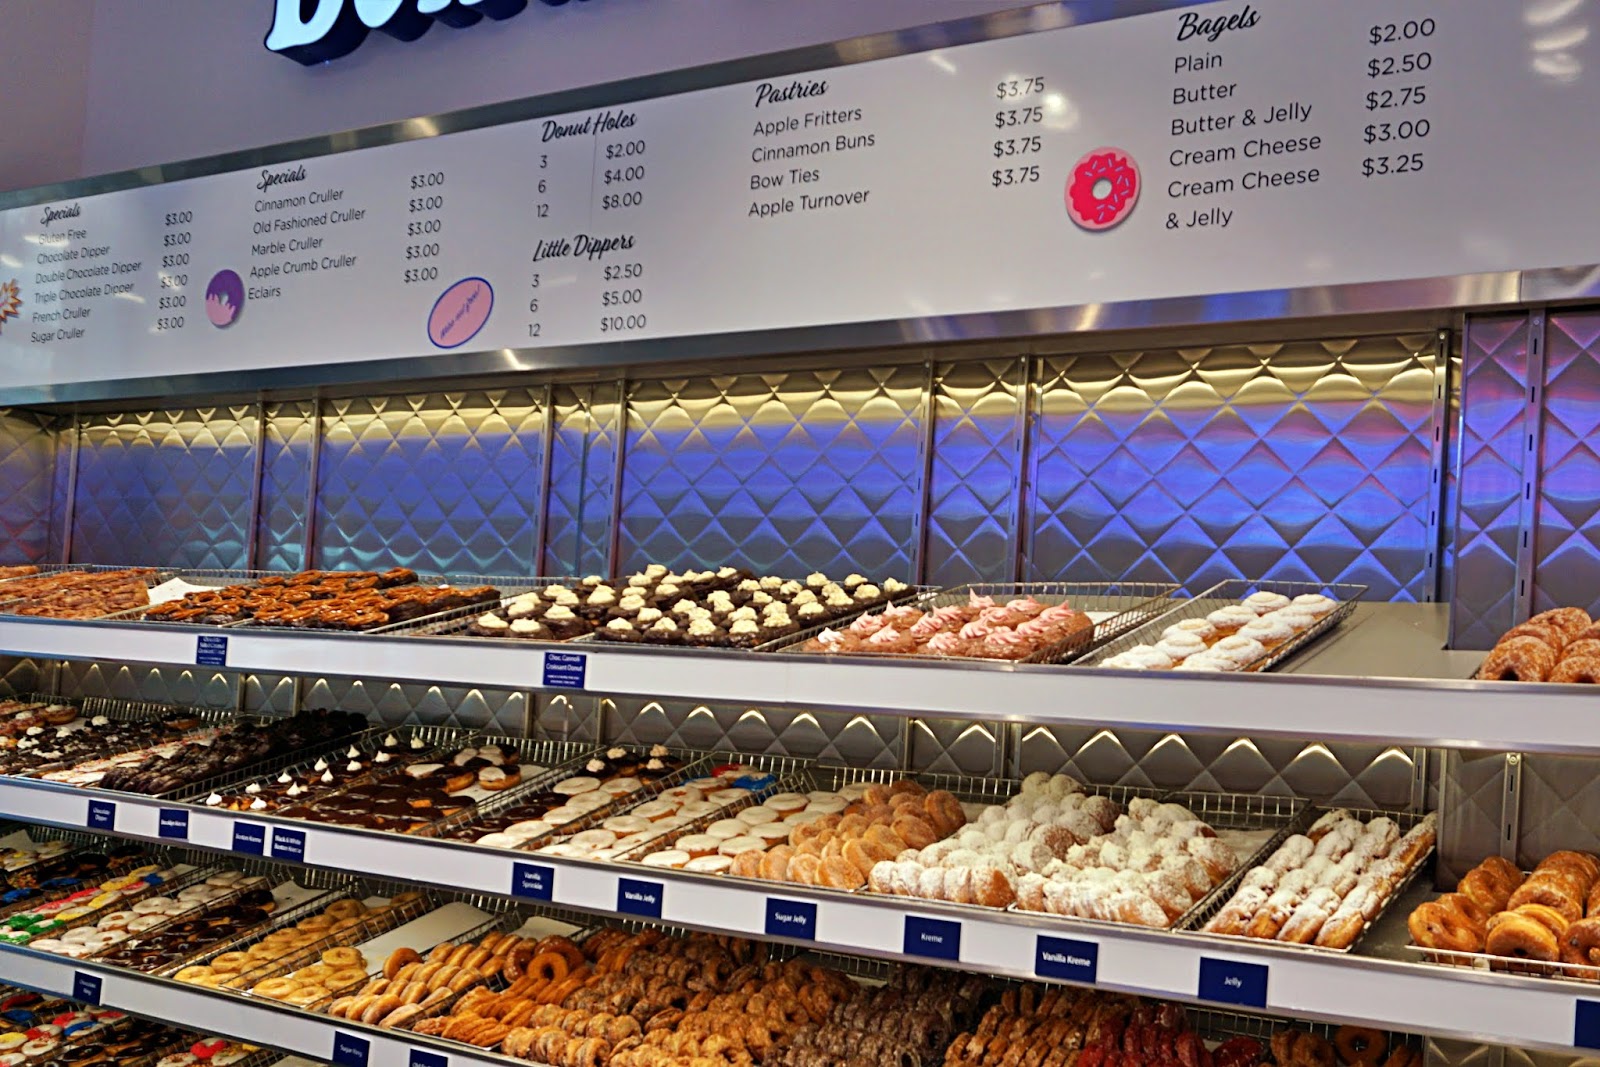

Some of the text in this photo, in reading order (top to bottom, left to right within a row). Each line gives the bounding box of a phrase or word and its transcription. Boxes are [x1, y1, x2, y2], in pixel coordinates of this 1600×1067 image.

[1177, 4, 1261, 43] Bagels
[1368, 18, 1436, 46] $2.00
[1174, 53, 1223, 74] Plain
[1367, 52, 1432, 78] $2.50
[755, 79, 828, 108] Pastries
[996, 77, 1045, 100] $3.75
[1172, 82, 1237, 105] Butter
[1365, 86, 1426, 111] $2.75
[541, 110, 637, 143] Donut Holes
[753, 107, 863, 137] Apple Fritters
[994, 107, 1043, 129] $3.75
[1171, 102, 1313, 136] Butter & Jelly
[1363, 118, 1431, 145] $3.00
[606, 140, 646, 160] $2.00
[752, 133, 875, 164] Cinnamon Buns
[993, 136, 1042, 159] $3.75
[1169, 134, 1322, 167] Cream Cheese
[539, 155, 548, 169] 3
[1361, 153, 1424, 178] $3.25
[257, 165, 307, 192] Specials
[410, 172, 444, 190] $3.00
[604, 165, 645, 185] $4.00
[750, 168, 820, 190] Bow Ties
[991, 165, 1040, 188] $3.75
[1167, 166, 1321, 198] Cream Cheese
[538, 180, 546, 194] 6
[254, 189, 344, 213] Cinnamon Cruller
[409, 196, 443, 213] $3.00
[602, 191, 643, 210] $8.00
[748, 189, 870, 218] Apple Turnover
[40, 203, 81, 227] Specials
[165, 211, 193, 226] $3.00
[537, 204, 549, 218] 12
[1165, 207, 1234, 230] & Jelly
[253, 209, 366, 235] Old Fashioned Cruller
[407, 219, 441, 237] $3.00
[38, 229, 87, 245] Gluten Free
[163, 232, 192, 247] $3.00
[251, 237, 324, 256] Marble Cruller
[37, 245, 110, 265] Chocolate Dipper
[405, 243, 440, 260] $3.00
[532, 233, 635, 262] Little Dippers
[162, 253, 190, 268] $3.00
[250, 255, 357, 280] Apple Crumb Cruller
[36, 261, 142, 284] Double Chocolate Dipper
[160, 274, 188, 289] $3.00
[404, 267, 438, 284] $3.00
[531, 274, 539, 288] 3
[603, 263, 643, 281] $2.50
[35, 282, 135, 305] Triple Chocolate Dipper
[159, 296, 186, 310] $3.00
[248, 287, 281, 300] Eclairs
[602, 288, 642, 307] $5.00
[33, 307, 91, 323] French Cruller
[530, 299, 538, 312] 6
[157, 316, 185, 331] $3.00
[528, 323, 541, 337] 12
[600, 314, 647, 333] $10.00
[31, 328, 85, 344] Sugar Cruller
[524, 872, 541, 880] Vanilla
[624, 891, 655, 903] Vanilla Jelly
[774, 912, 807, 925] Sugar Jelly
[920, 932, 943, 943] Kreme
[1042, 951, 1091, 967] Vanilla Kreme
[1224, 976, 1242, 988] Jelly
